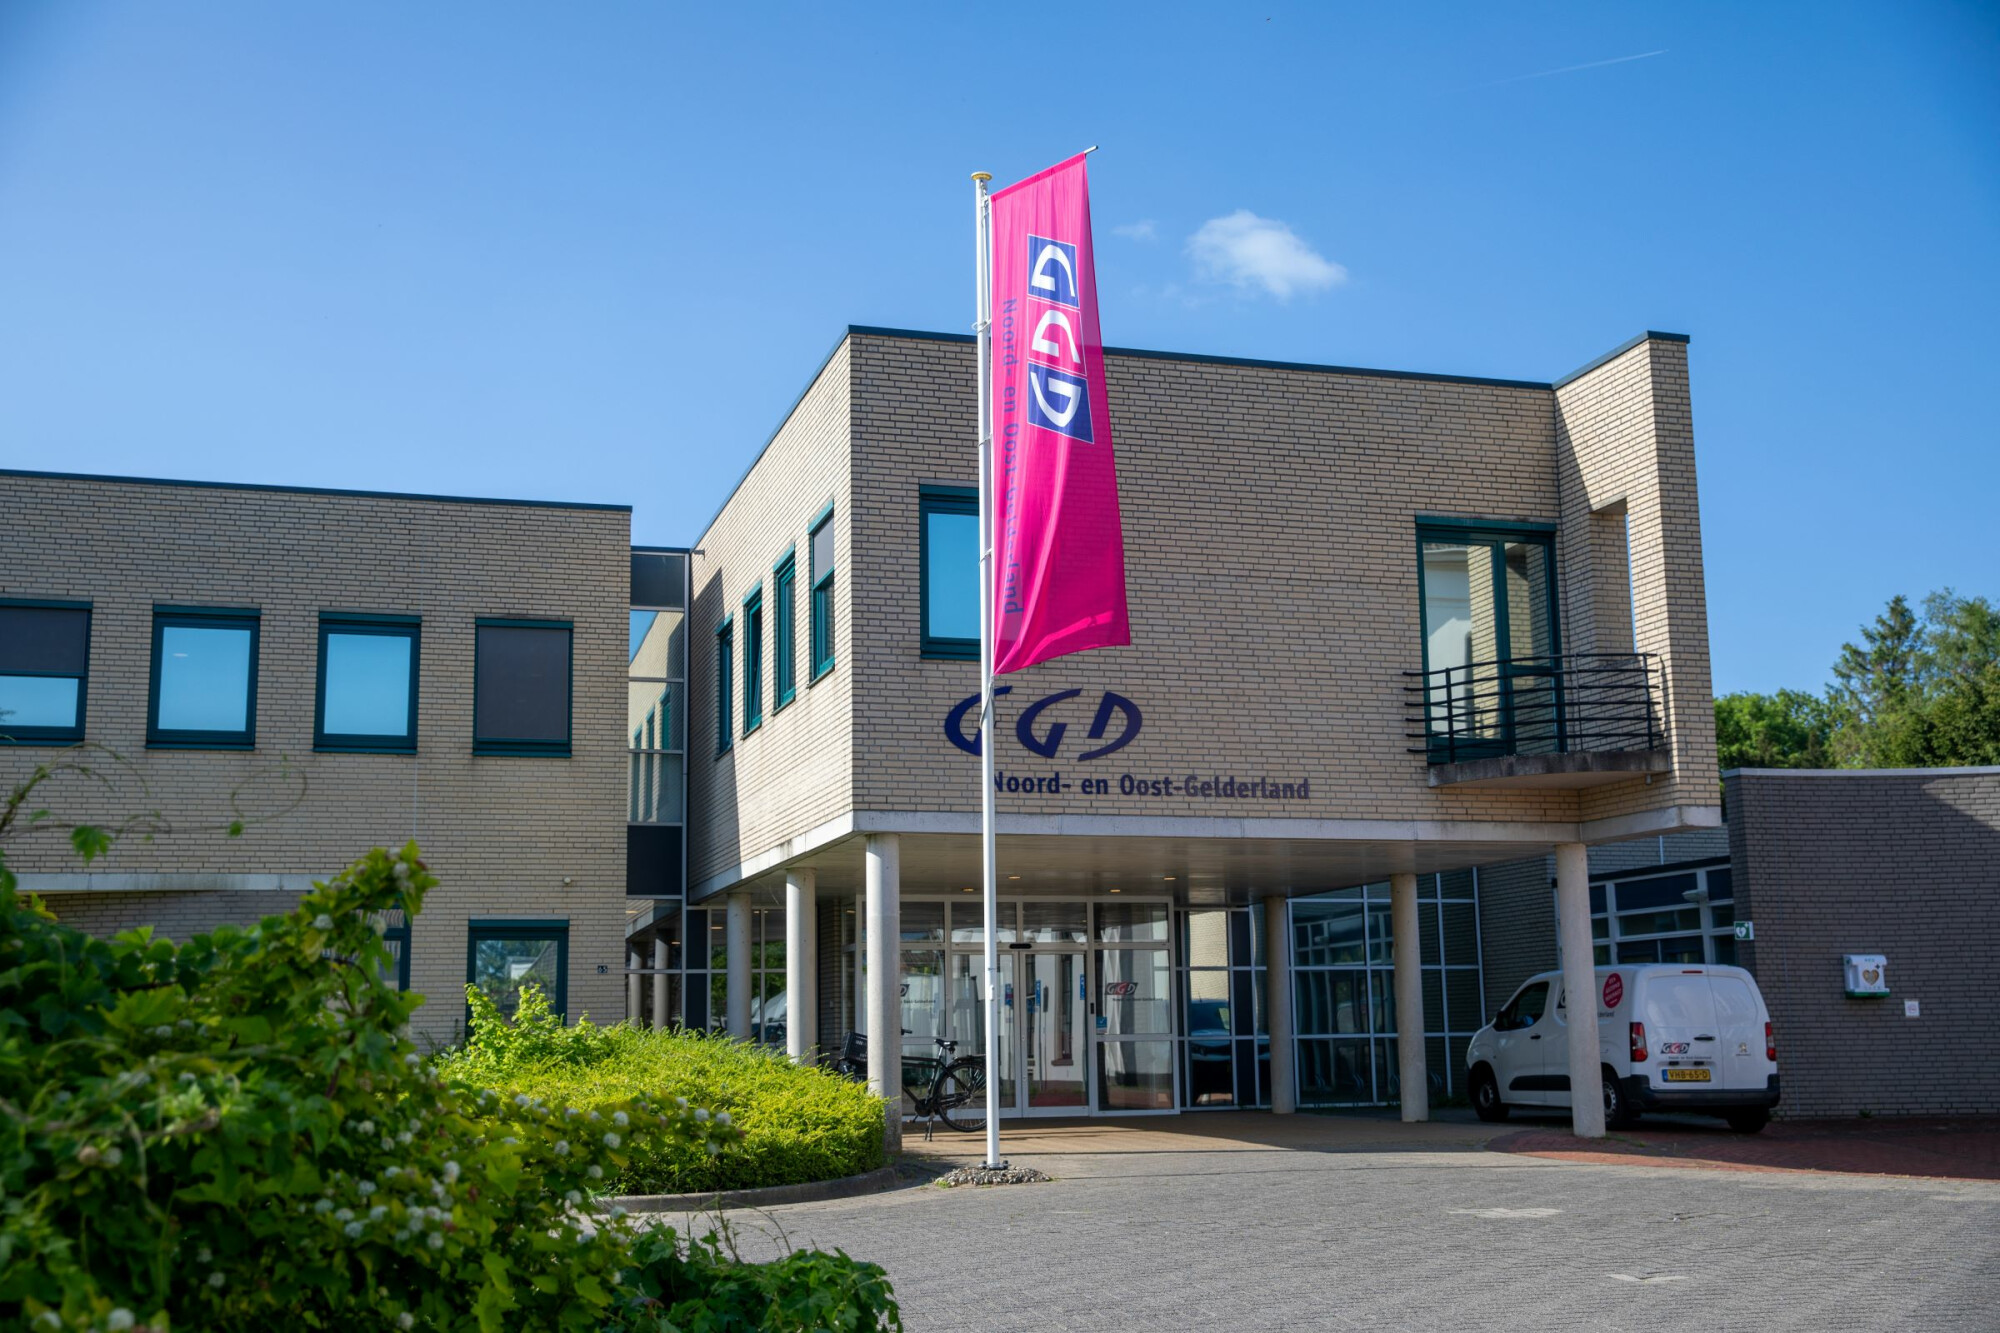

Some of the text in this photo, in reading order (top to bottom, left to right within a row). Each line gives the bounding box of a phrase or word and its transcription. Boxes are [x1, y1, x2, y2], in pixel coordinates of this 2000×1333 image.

[1002, 298, 1019, 377] Noord-
[1030, 244, 1081, 428] GGD
[1003, 386, 1017, 413] en
[944, 685, 1143, 762] GGD
[994, 771, 1310, 799] Noord- en Oost-Gelderland
[1106, 983, 1136, 995] GGD
[1662, 1043, 1689, 1054] GGD
[1668, 1069, 1708, 1080] VHB-65-D
